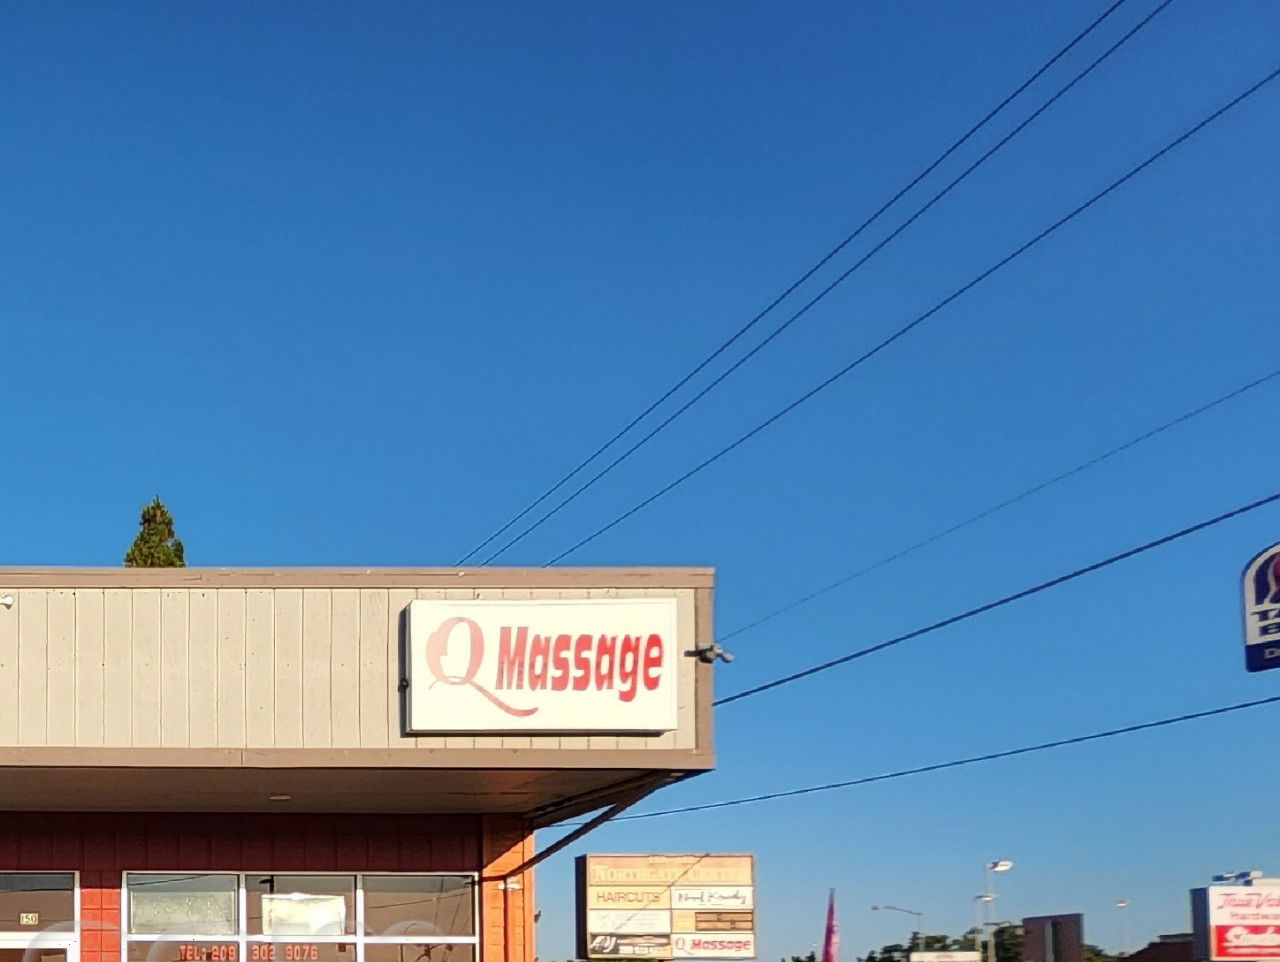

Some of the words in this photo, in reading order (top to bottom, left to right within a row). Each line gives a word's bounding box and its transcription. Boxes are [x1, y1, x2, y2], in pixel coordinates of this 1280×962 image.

[425, 616, 540, 718] Q
[495, 626, 665, 703] Massage
[691, 939, 752, 951] Massage
